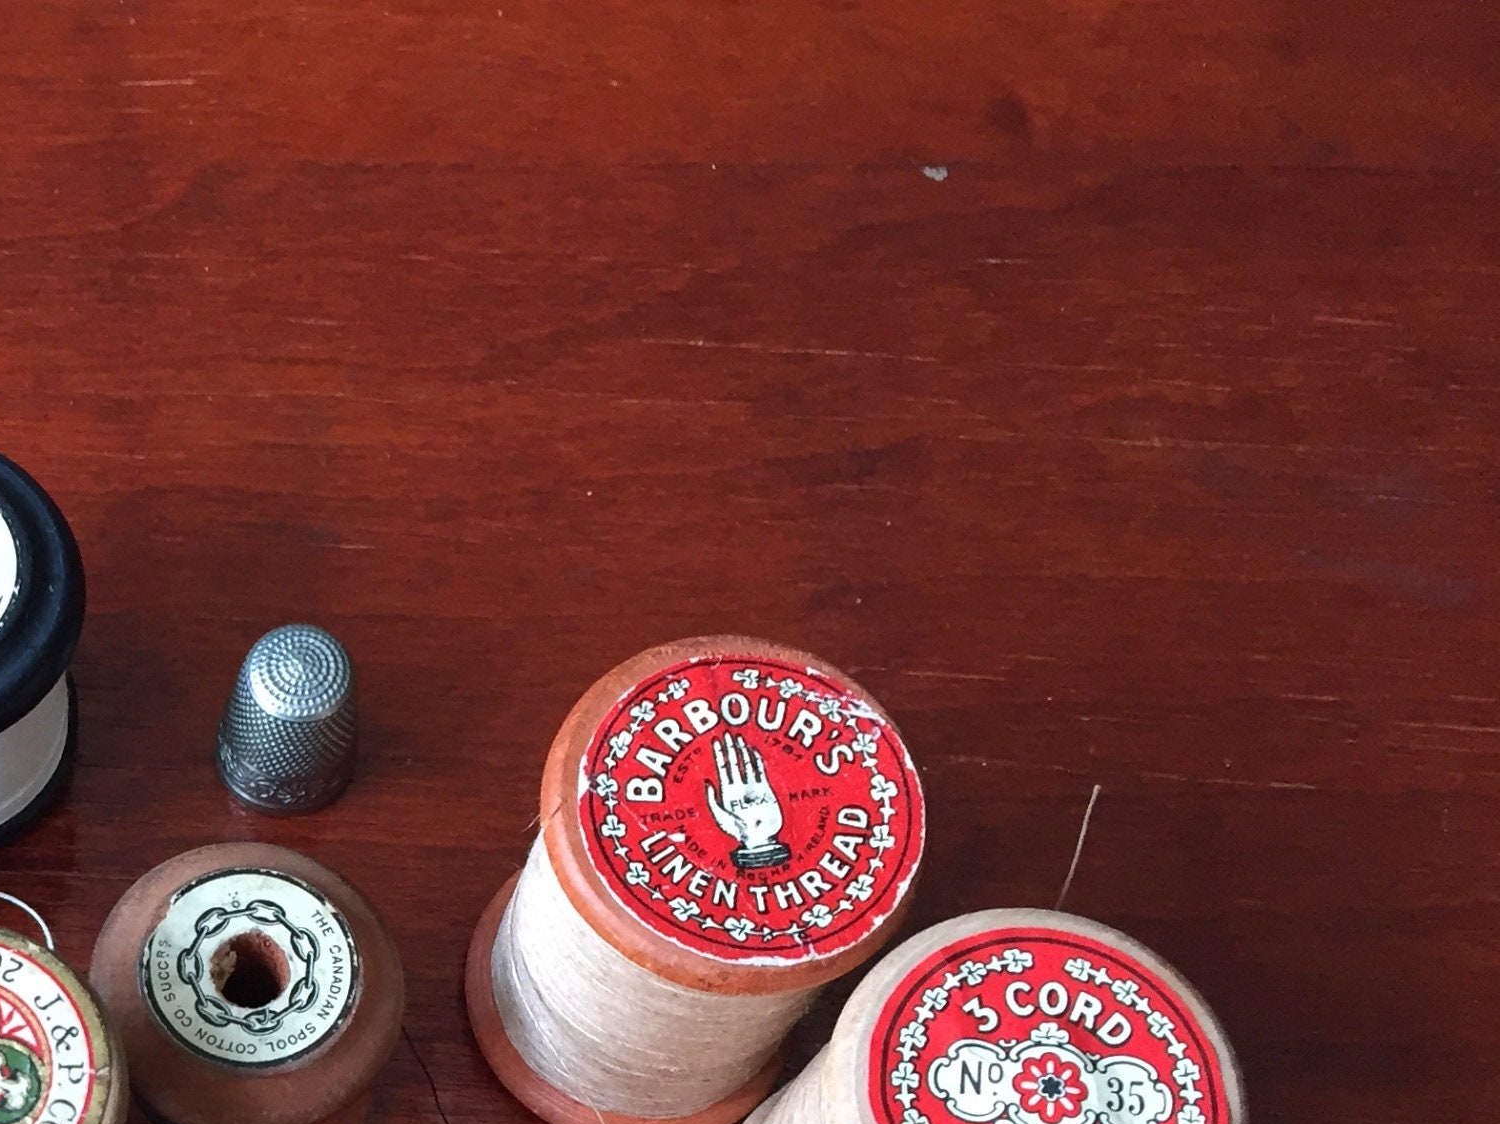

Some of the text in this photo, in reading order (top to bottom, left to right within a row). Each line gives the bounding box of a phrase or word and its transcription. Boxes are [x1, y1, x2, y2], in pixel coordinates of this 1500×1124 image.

[626, 693, 854, 802] BARBOUR'S
[641, 808, 696, 825] TRADE
[641, 806, 871, 914] LINEN THREAD
[311, 910, 335, 937] THE
[316, 944, 344, 1021] CANADIAN
[963, 981, 1133, 1046] 3 CORD
[195, 1028, 257, 1055] COTTON
[266, 1023, 317, 1052] SPOOL
[1106, 1077, 1145, 1115] 35
